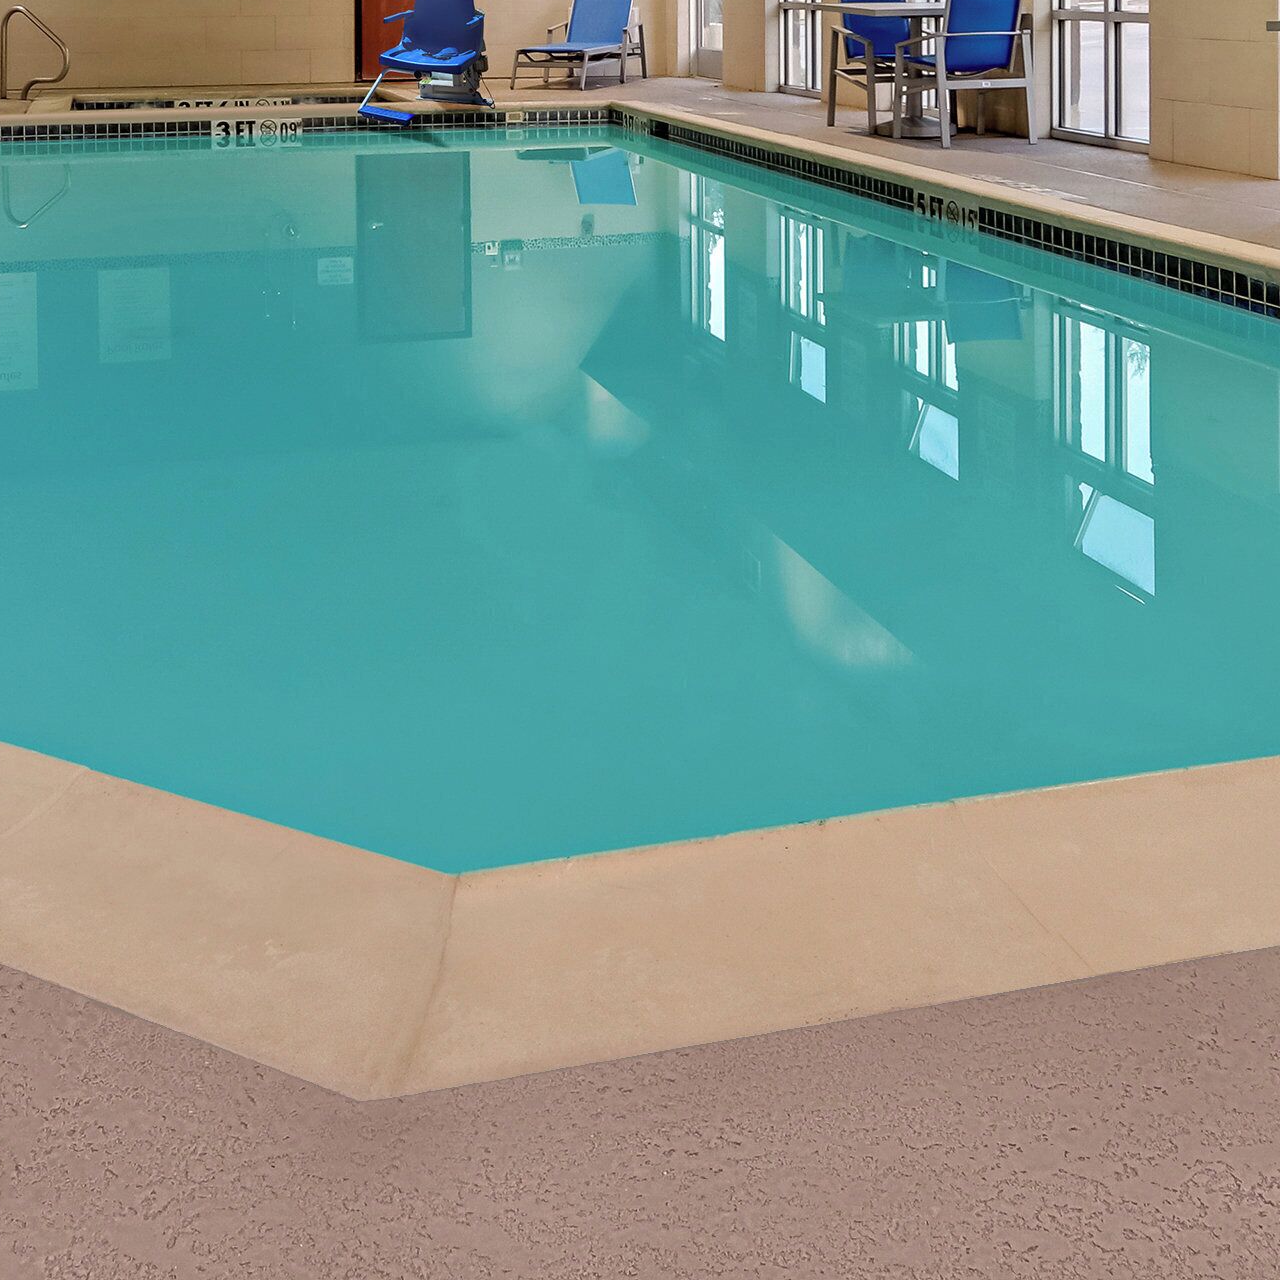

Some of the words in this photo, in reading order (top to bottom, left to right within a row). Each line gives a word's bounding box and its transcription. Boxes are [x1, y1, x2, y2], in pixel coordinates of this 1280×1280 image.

[215, 121, 230, 136] 3
[236, 121, 256, 136] FT
[917, 192, 925, 215] 5
[929, 195, 944, 220] FT
